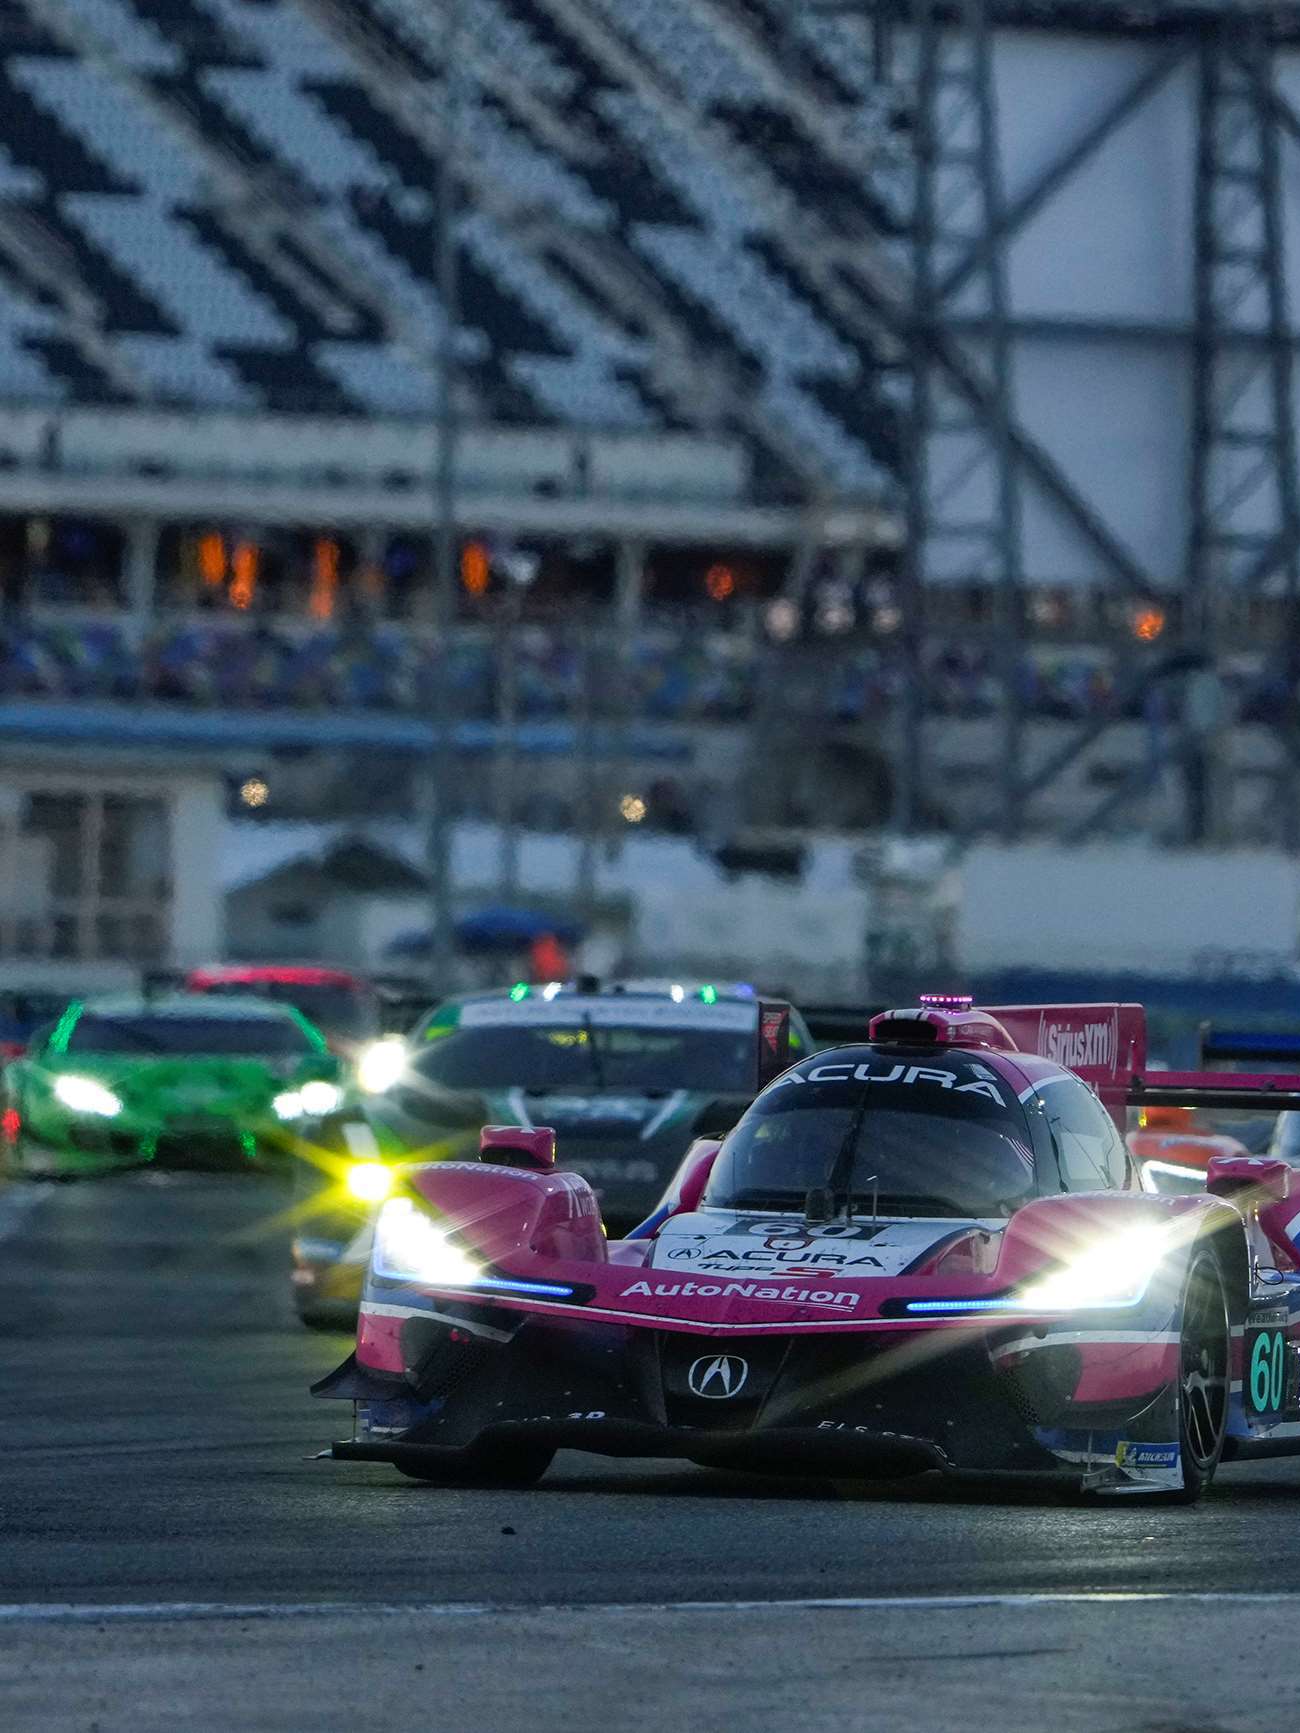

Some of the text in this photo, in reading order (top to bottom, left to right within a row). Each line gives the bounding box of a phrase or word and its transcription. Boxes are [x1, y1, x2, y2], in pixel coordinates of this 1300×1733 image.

[1047, 1024, 1108, 1066] SiriusXM
[764, 1063, 1007, 1107] ACURA
[747, 1222, 862, 1240] 60
[702, 1250, 886, 1271] ACURA
[621, 1281, 861, 1305] AutoNation
[1250, 1331, 1284, 1411] 60
